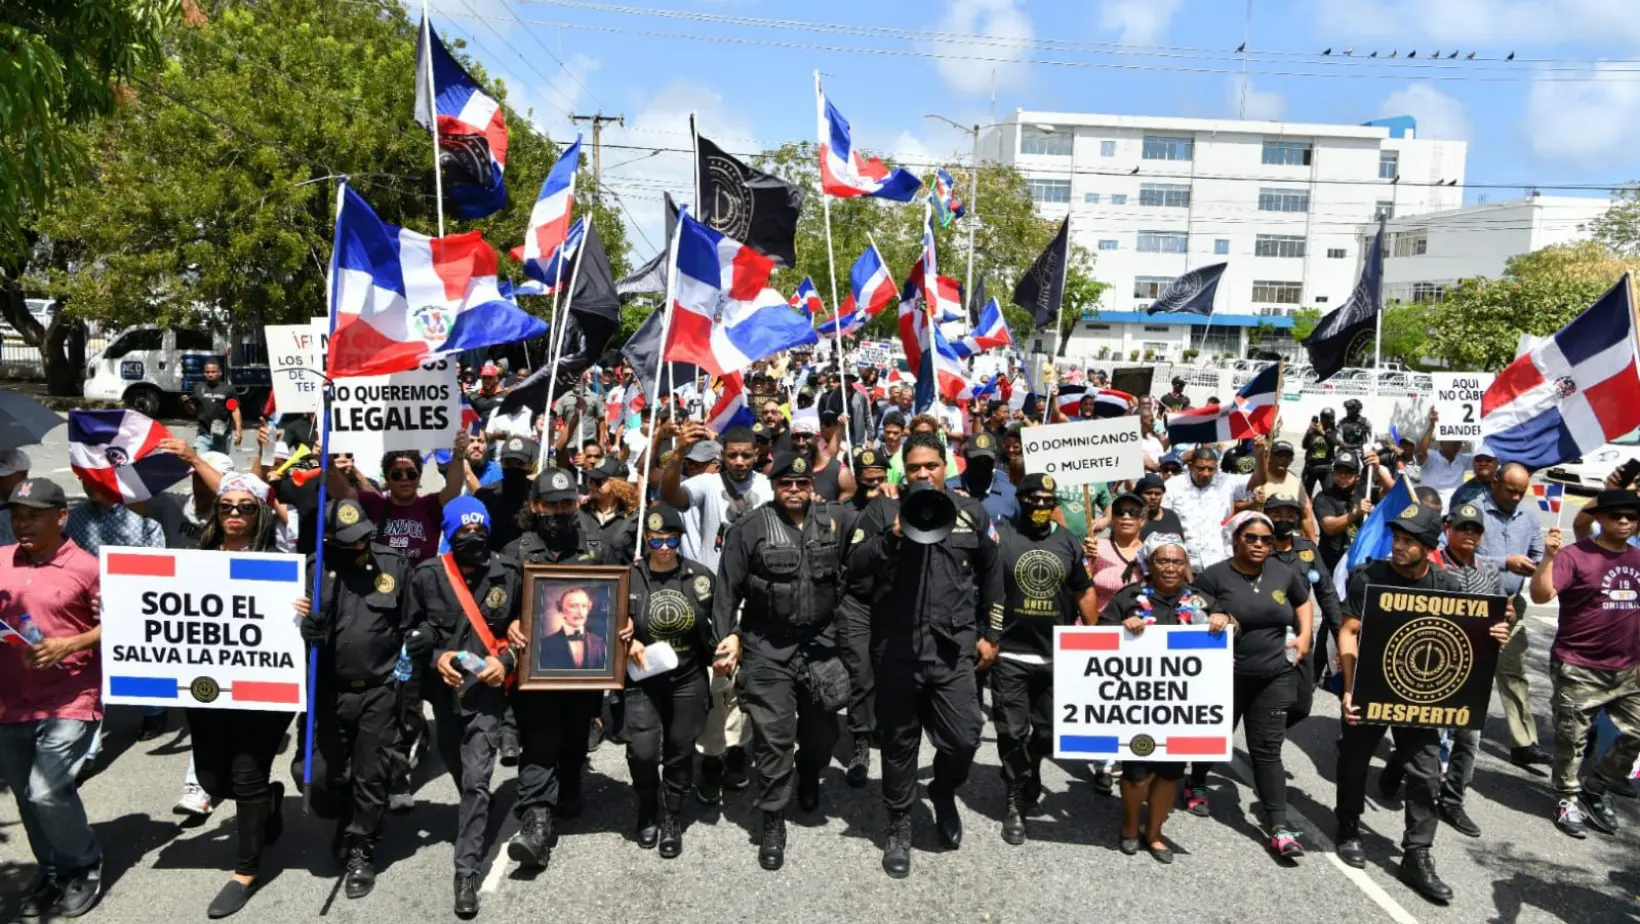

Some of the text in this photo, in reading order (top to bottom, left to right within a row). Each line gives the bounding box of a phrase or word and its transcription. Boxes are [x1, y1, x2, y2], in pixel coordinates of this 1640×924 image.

[278, 356, 304, 366] LOS
[288, 370, 305, 380] DE
[1452, 378, 1479, 391] AQUI
[354, 384, 449, 404] QUEREMOS
[1439, 390, 1485, 401] NO CABE
[1462, 403, 1475, 423] 2
[1042, 431, 1139, 451] DOMINICANOS
[1046, 463, 1056, 473] O
[461, 512, 485, 525] BOY
[141, 591, 265, 619] SOLO EL
[1379, 592, 1489, 618] QUISQUEYA
[144, 620, 262, 647] PUEBLO
[113, 645, 295, 668] SALVA LA PATRIA
[1083, 656, 1202, 682] AQUI NO
[1098, 681, 1188, 701] CABEN
[1062, 703, 1224, 725] 2 NACIONES
[1366, 702, 1470, 726] DESPERTÓ
